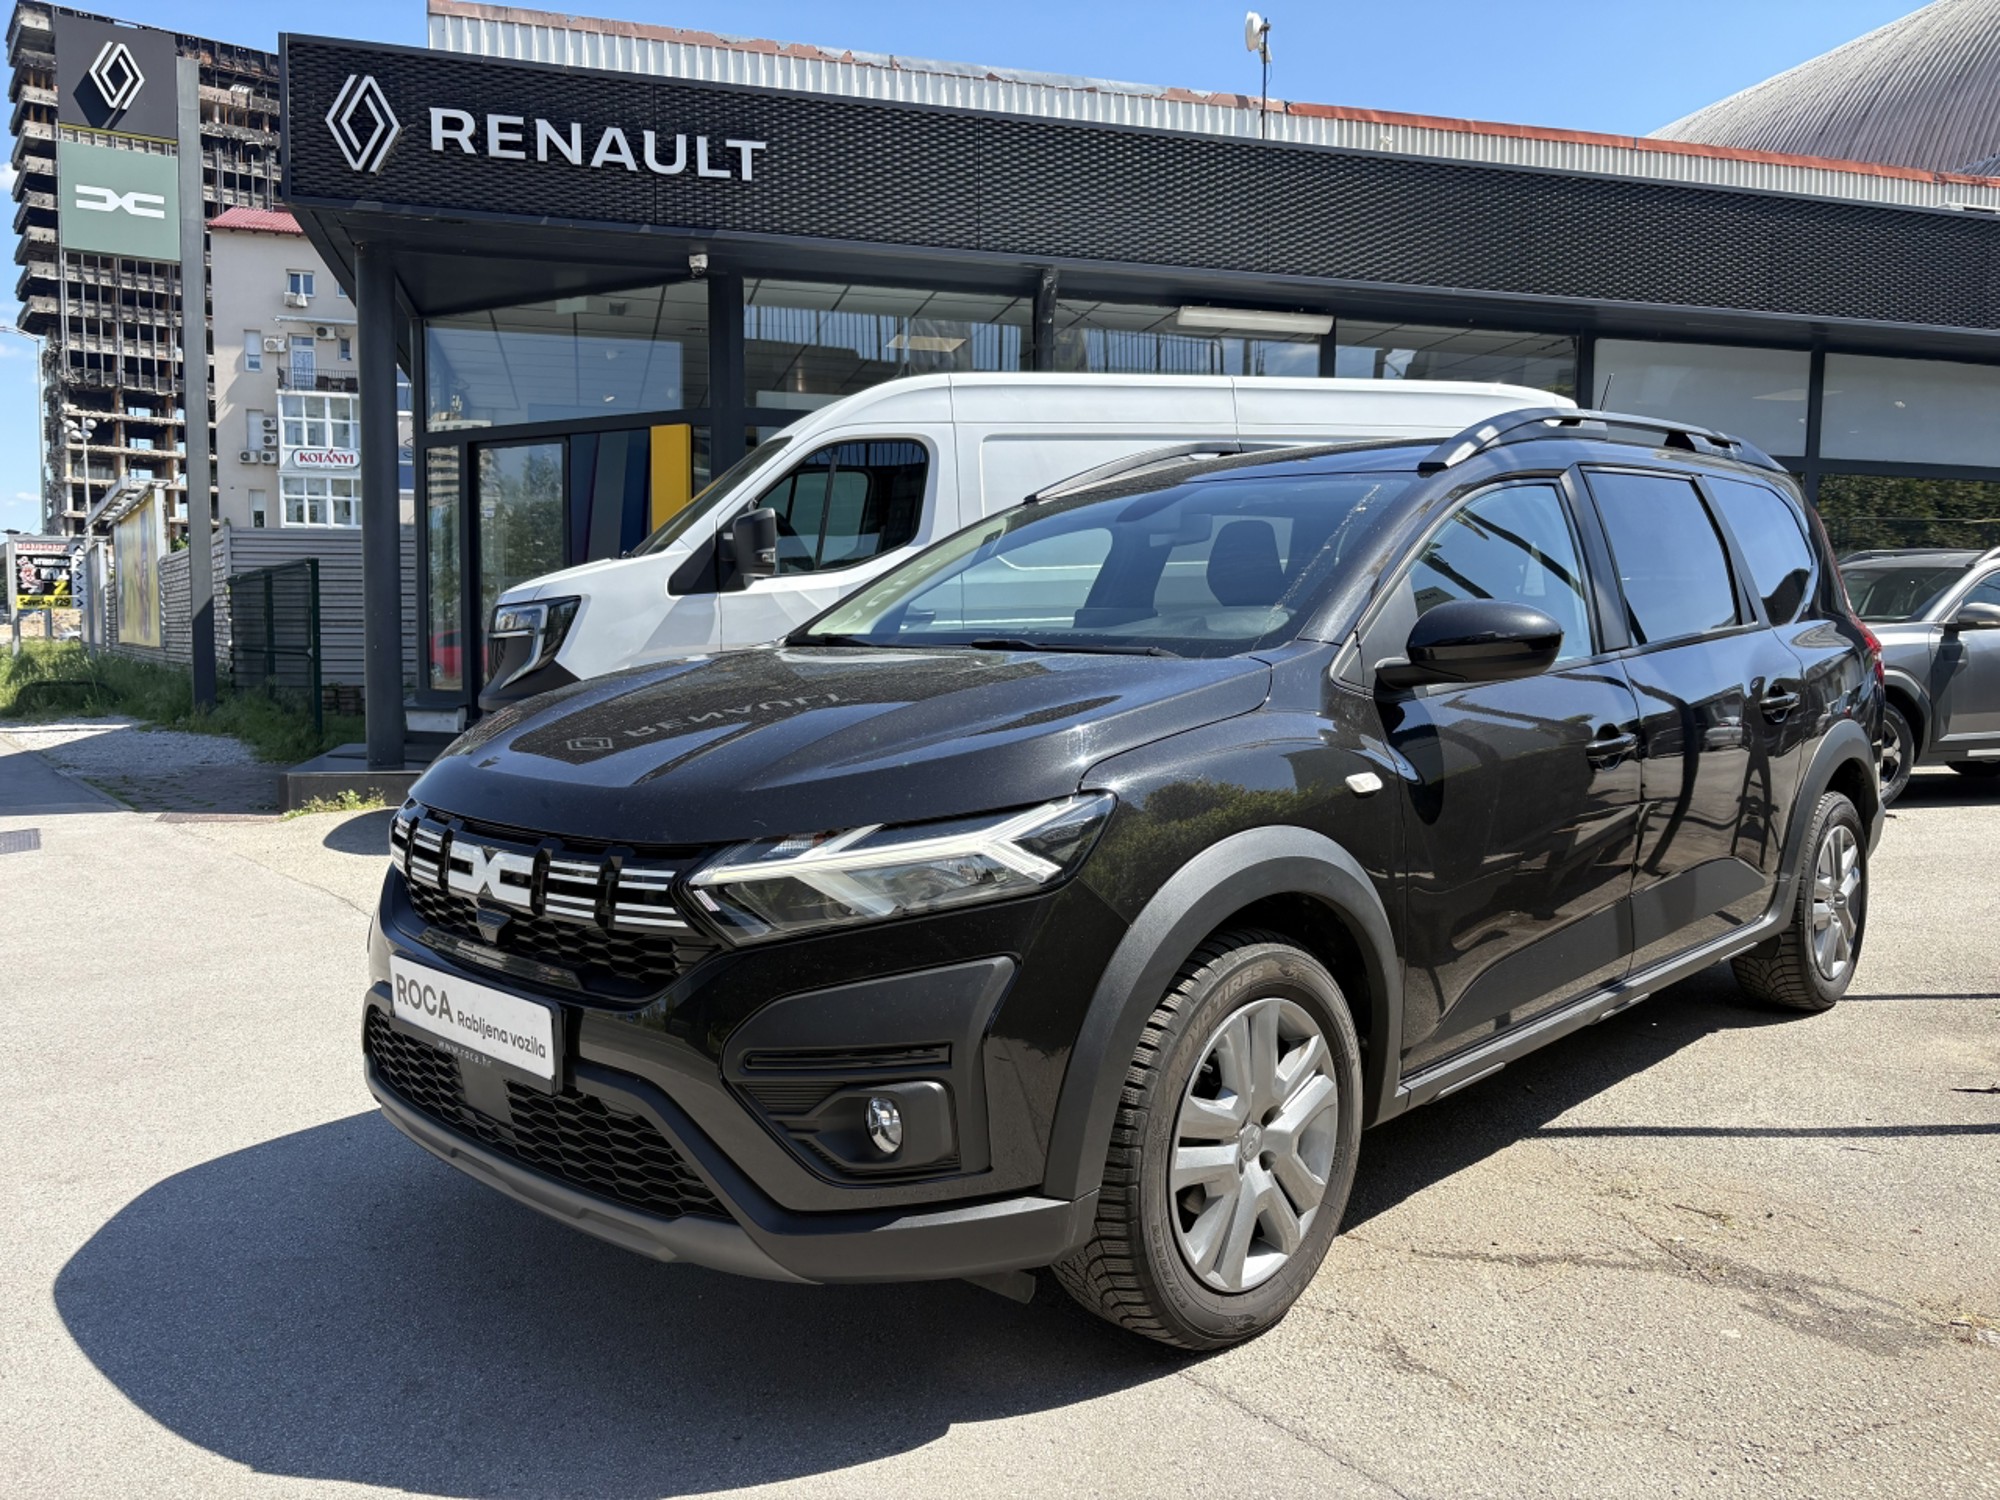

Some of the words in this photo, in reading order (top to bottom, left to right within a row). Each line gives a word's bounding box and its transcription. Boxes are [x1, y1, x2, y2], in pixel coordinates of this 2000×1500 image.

[428, 106, 768, 182] RENAULT
[299, 448, 354, 464] KOTÁNYI
[395, 972, 455, 1024] ROCA
[457, 1010, 509, 1045] Rabljena
[509, 1031, 547, 1060] vozila
[1213, 964, 1265, 1012] TIRES
